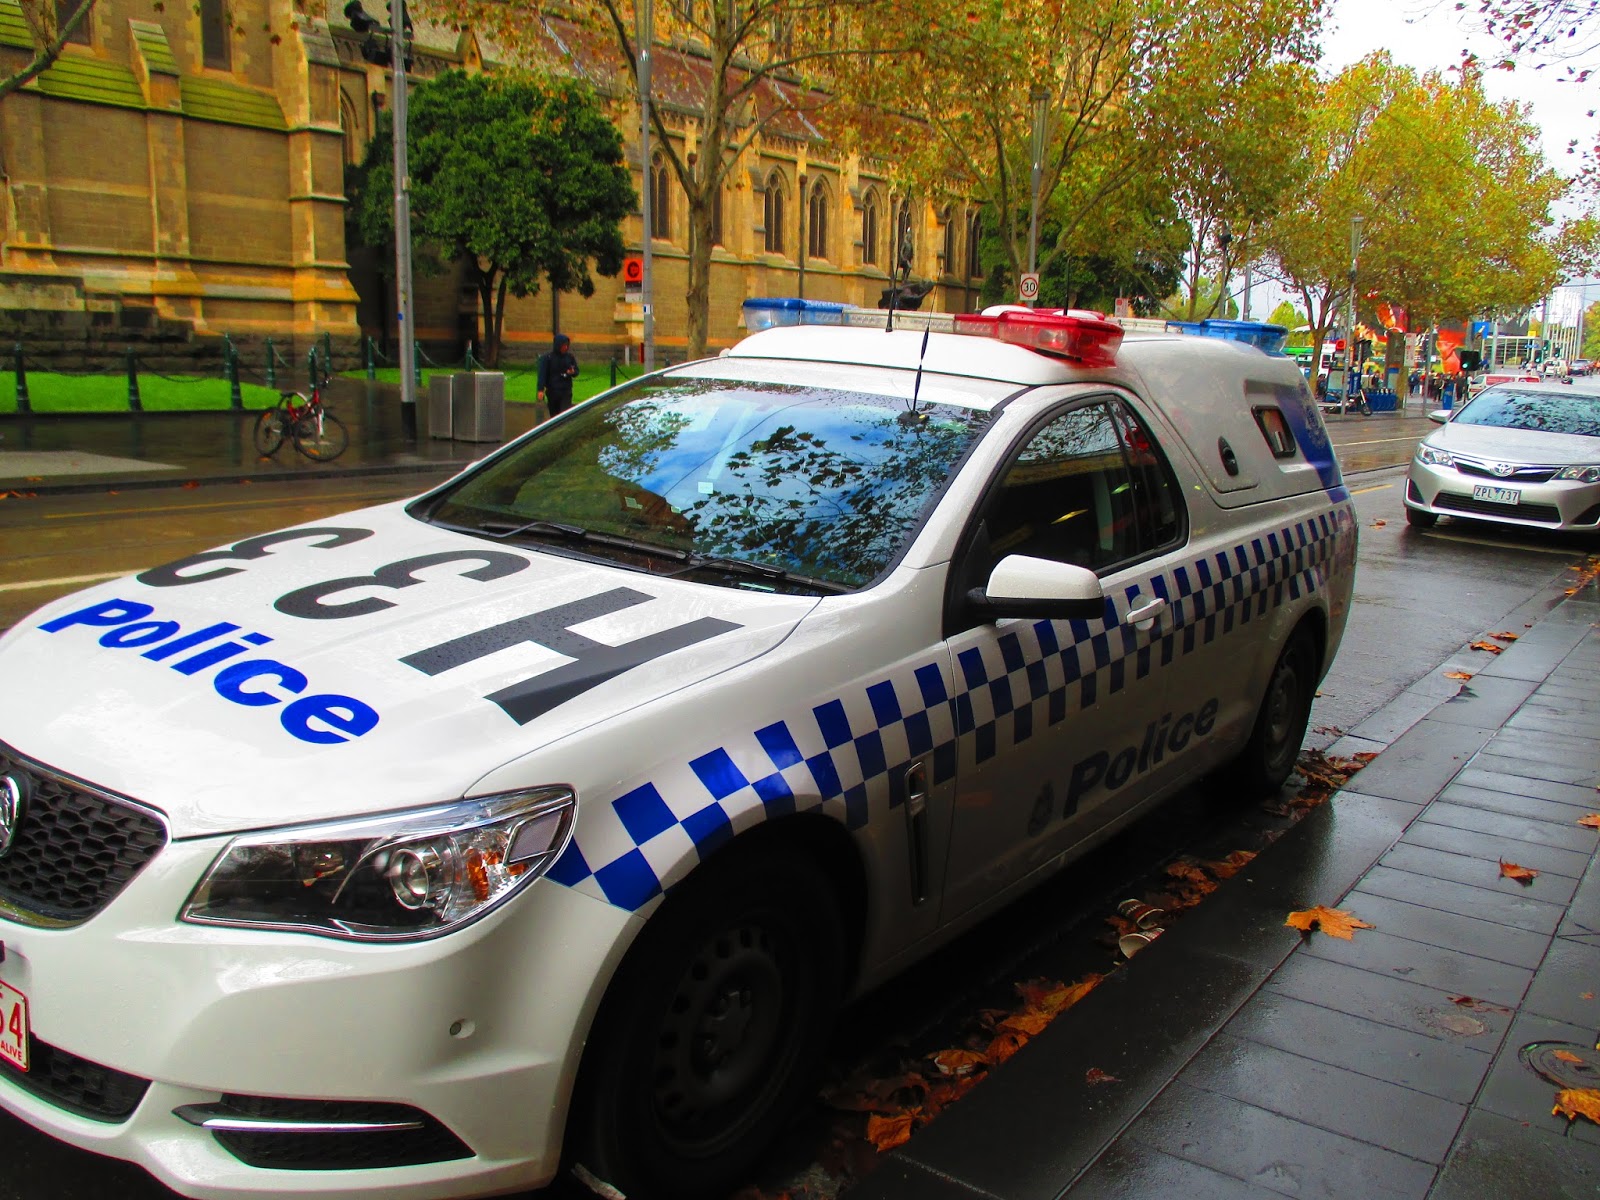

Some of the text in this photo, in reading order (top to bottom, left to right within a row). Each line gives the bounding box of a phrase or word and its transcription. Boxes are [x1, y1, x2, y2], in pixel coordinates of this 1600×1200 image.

[1023, 282, 1036, 292] 30
[1475, 487, 1492, 498] ZPL
[1500, 490, 1518, 501] 737
[38, 598, 380, 744] Police
[1063, 697, 1219, 820] Police
[0, 1041, 23, 1061] ALIVE
